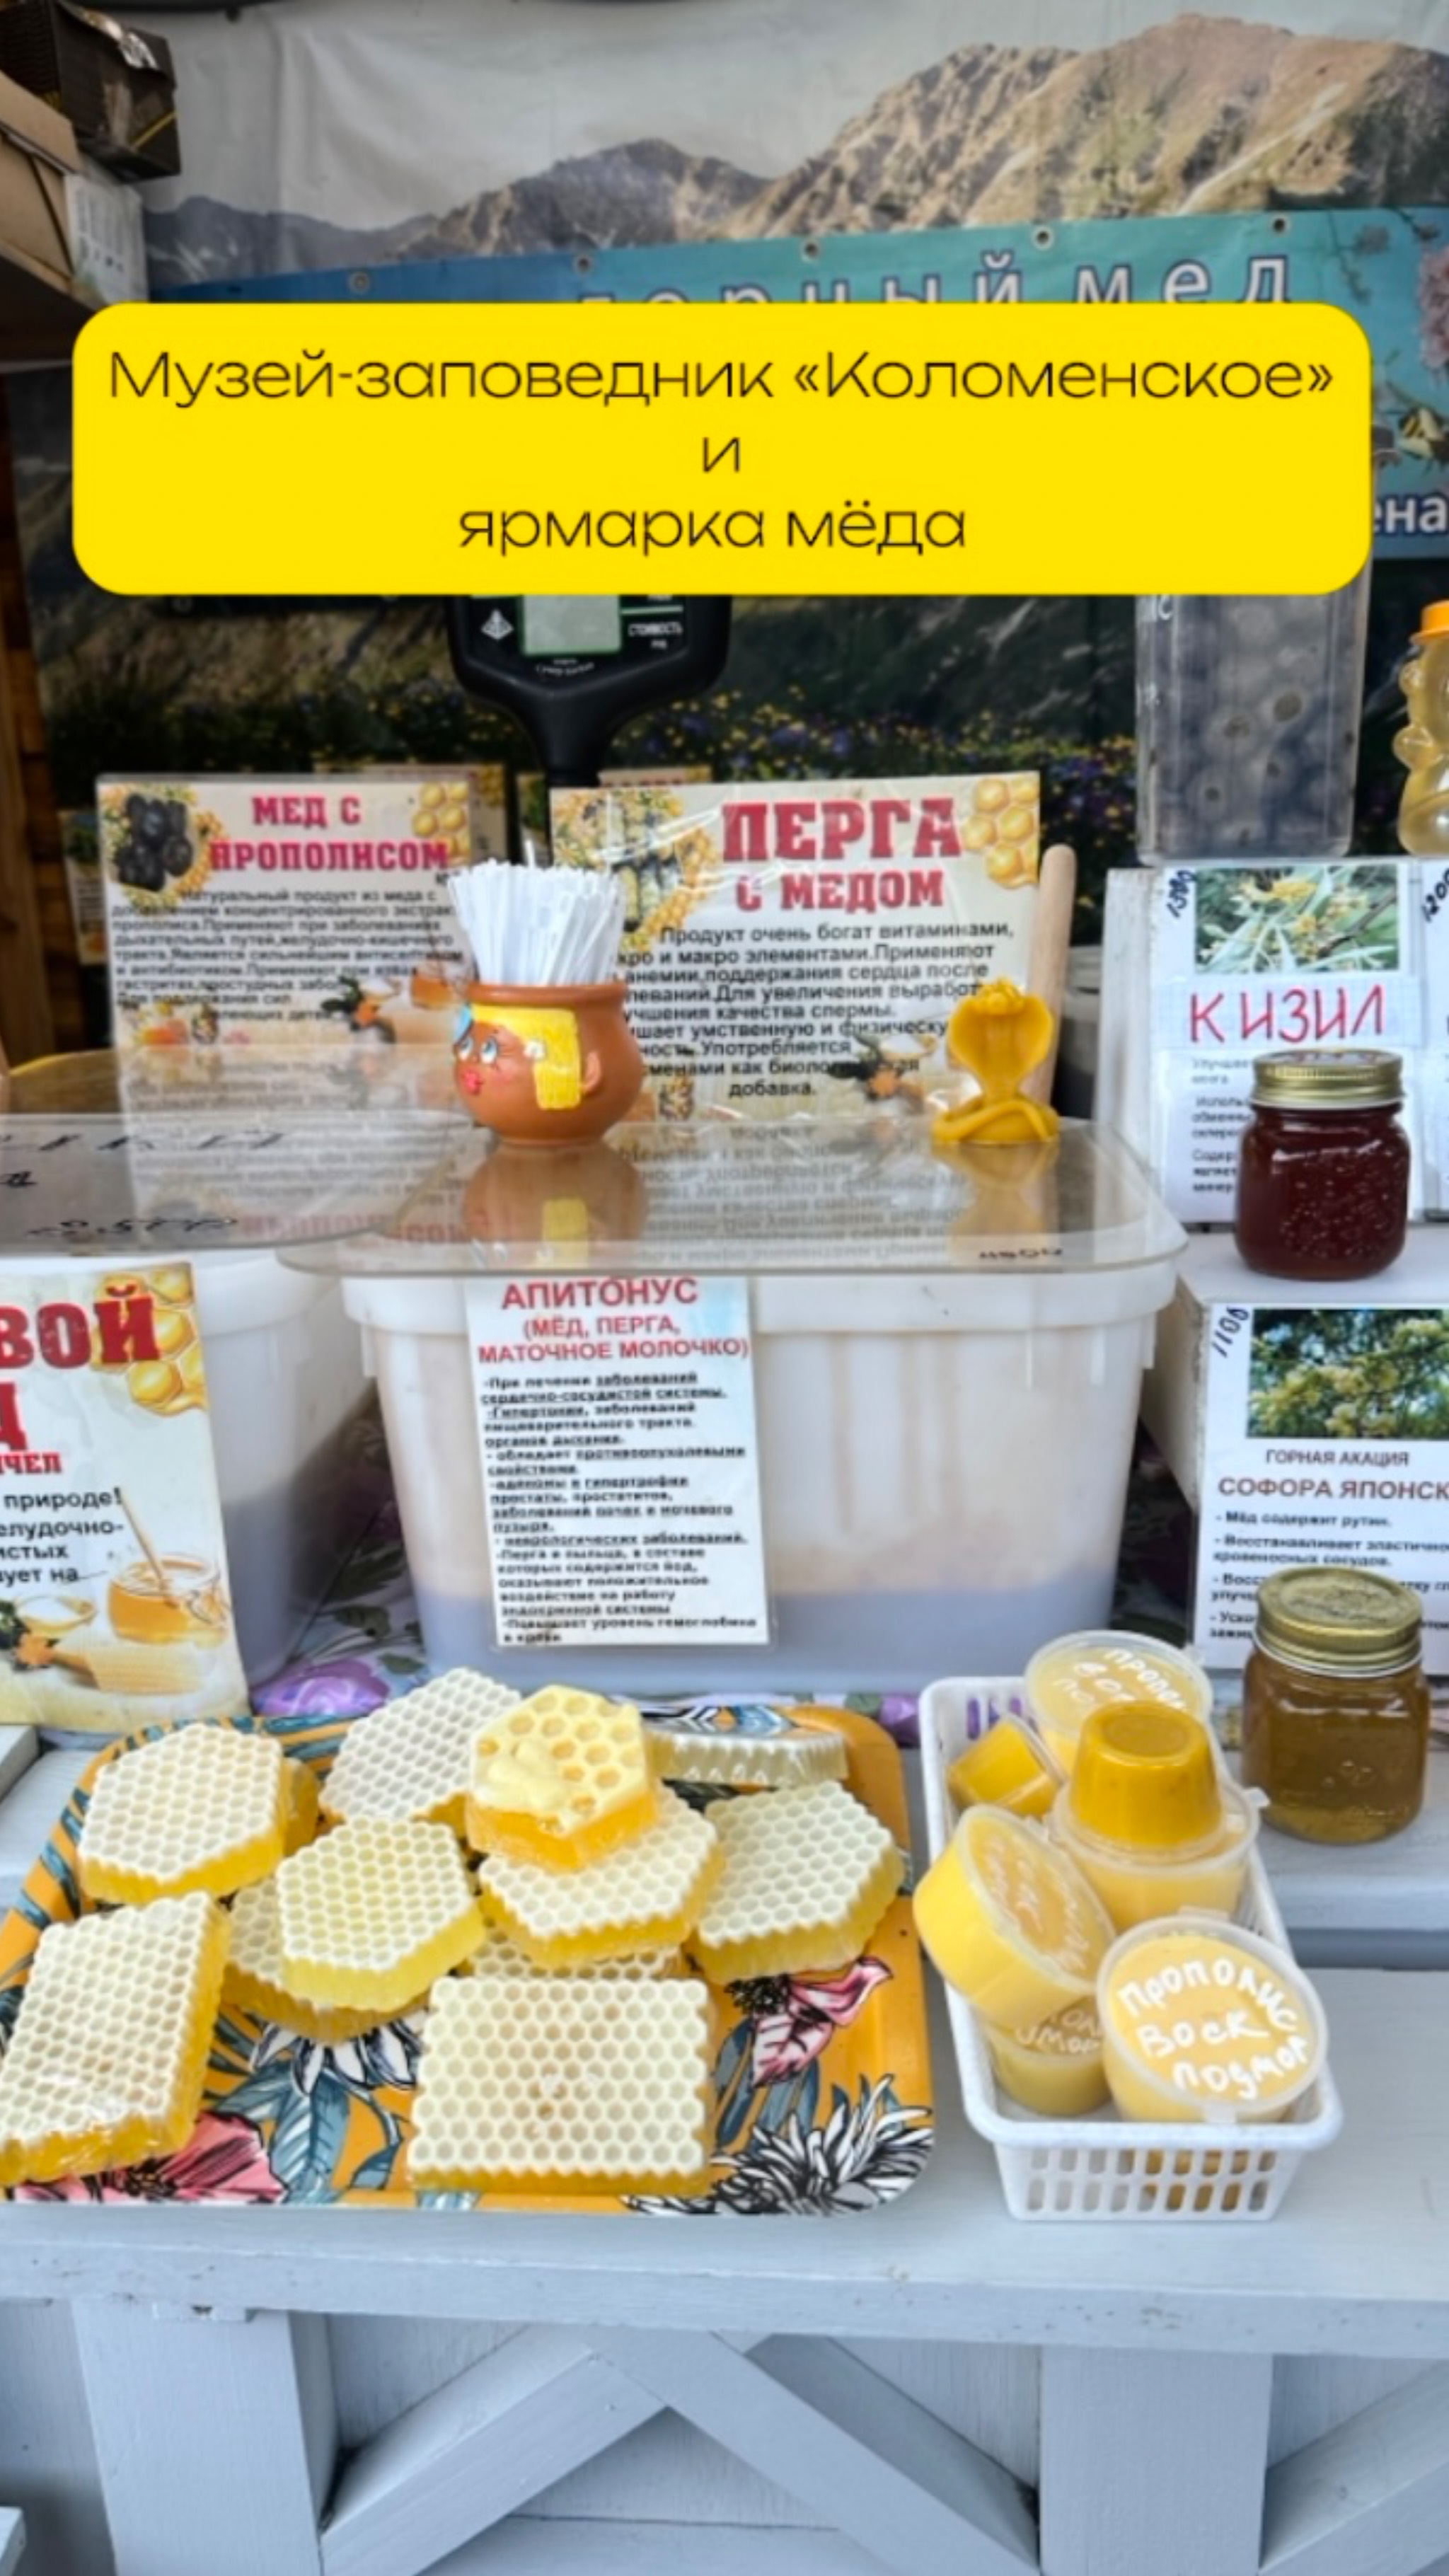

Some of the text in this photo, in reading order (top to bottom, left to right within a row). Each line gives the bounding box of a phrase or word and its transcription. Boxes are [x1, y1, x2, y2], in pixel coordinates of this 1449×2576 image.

[252, 795, 362, 827] МЕД С
[721, 797, 964, 862] ПЕРГА
[782, 870, 945, 914] МЕДОМ
[659, 921, 1015, 947] Продукт очень богат витаминами,
[659, 951, 671, 964] и
[678, 951, 740, 966] макро
[848, 964, 923, 981] сердца
[926, 964, 990, 978] после
[761, 983, 884, 1005] увеличения
[889, 979, 982, 1000] выработ
[716, 1005, 805, 1020] качества
[810, 1003, 896, 1022] спермы.
[1189, 983, 1385, 1044] КИЗИЛ
[690, 1022, 814, 1041] умственную
[821, 1022, 833, 1035] и
[839, 1017, 949, 1038] физическу
[731, 1061, 763, 1075] как
[728, 1078, 814, 1099] добавка.
[502, 1276, 698, 1310] АПИТОНУС
[523, 1314, 681, 1342] (МЁД, ПЕРГА,
[478, 1337, 749, 1365] МАТОЧНОЕ МОЛОЧКО)
[0, 1450, 62, 1475] ЧЕЛ
[1266, 1449, 1411, 1468] ГОРНАЯ АКАЦИЯ
[3, 1486, 123, 1513] природе!
[1218, 1477, 1334, 1498] СОФОРА
[0, 1544, 69, 1560] стых
